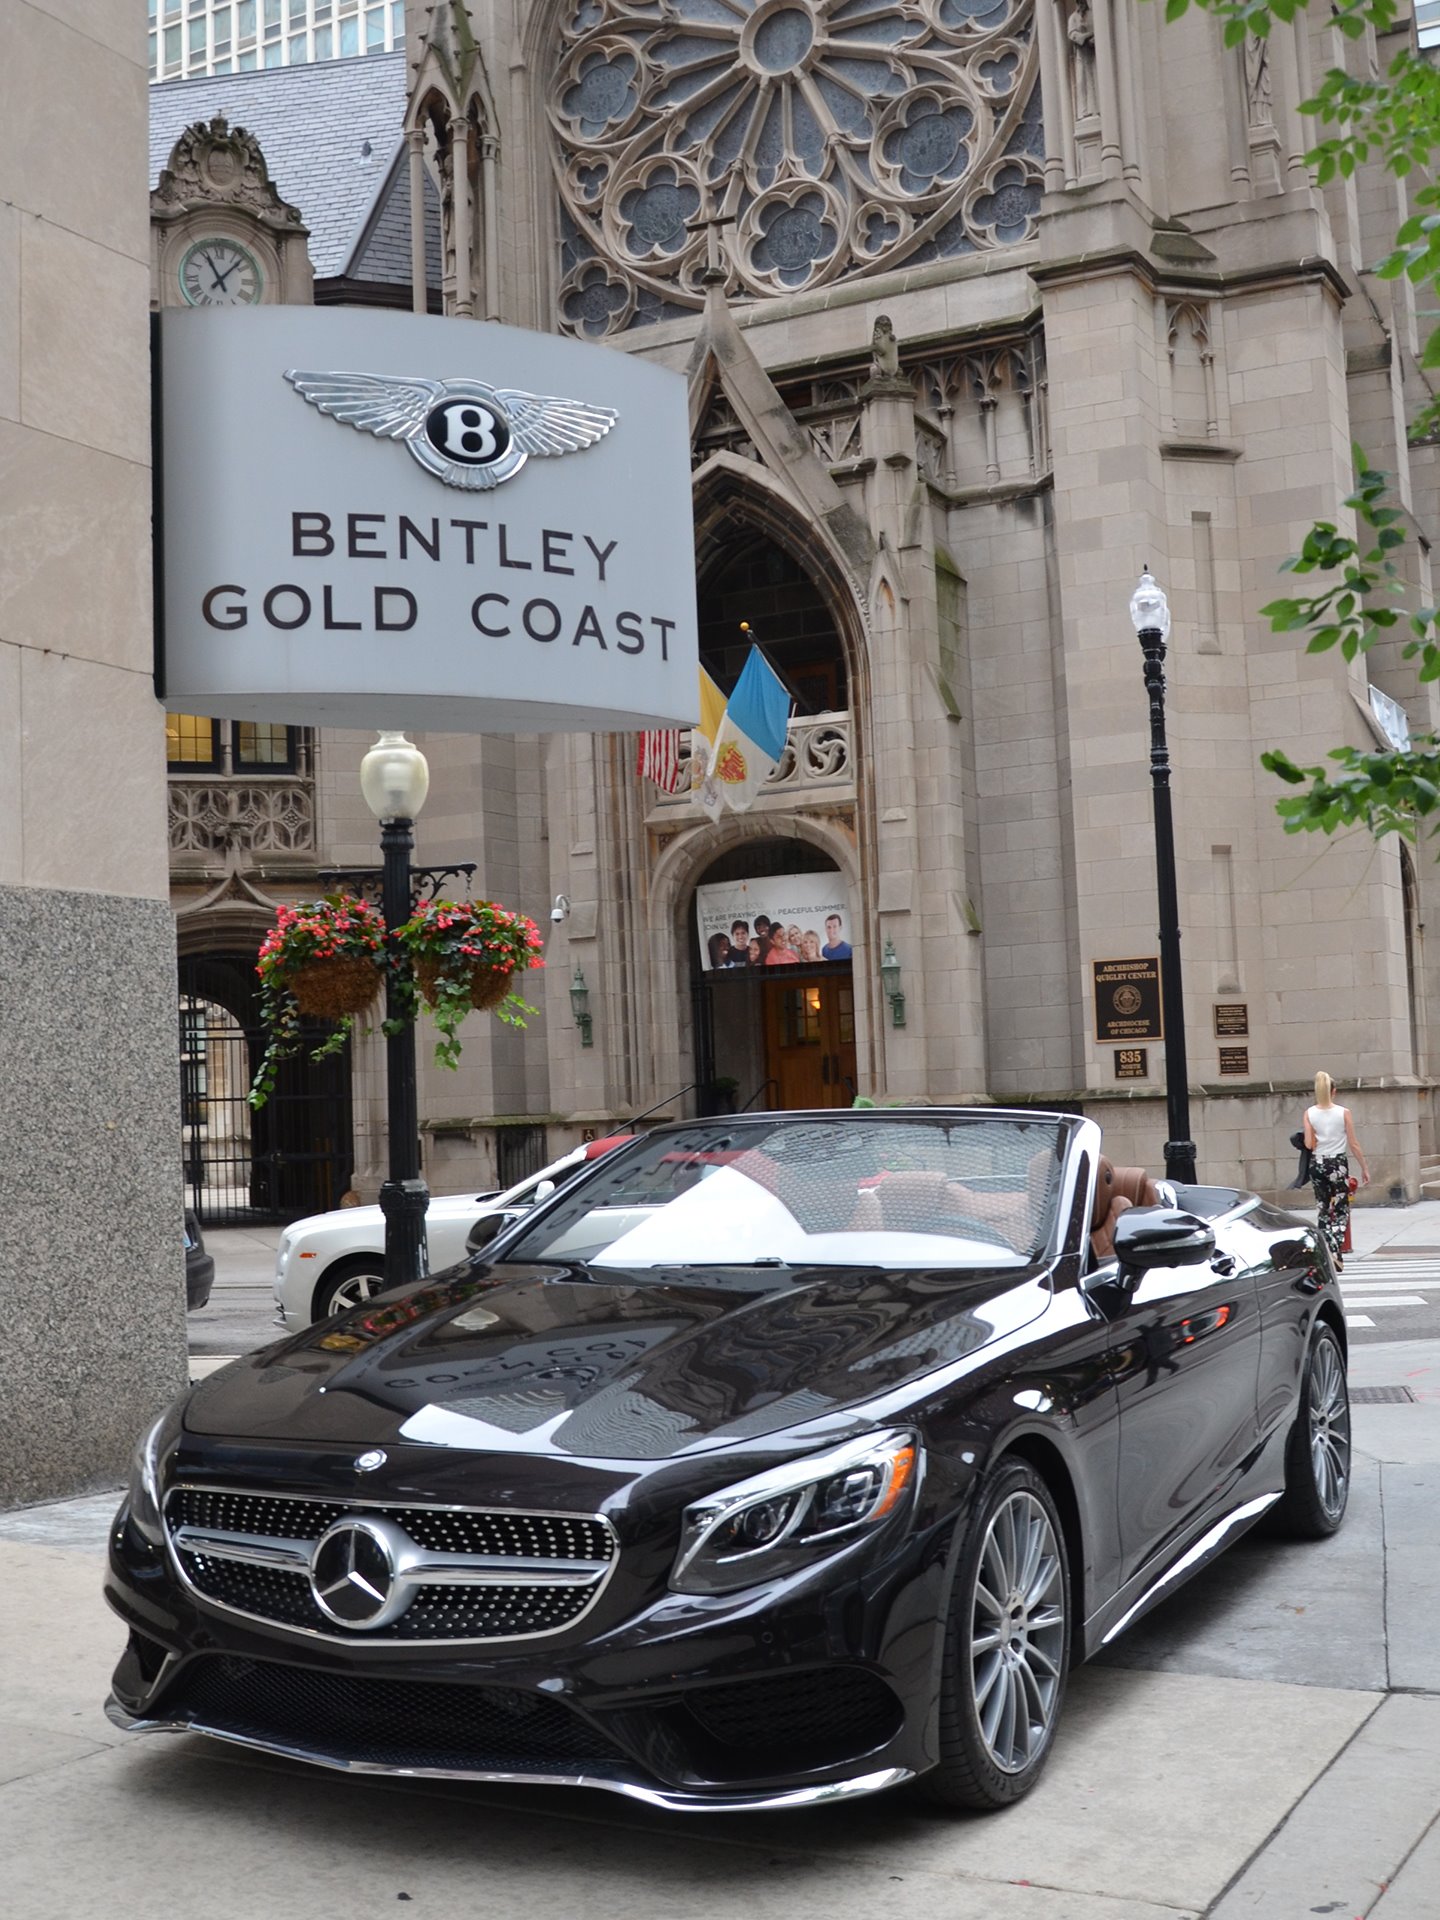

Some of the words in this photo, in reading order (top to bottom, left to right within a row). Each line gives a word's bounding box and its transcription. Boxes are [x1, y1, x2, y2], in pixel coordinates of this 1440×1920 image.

[443, 403, 498, 457] B
[292, 512, 617, 580] BENTLEY
[202, 584, 417, 631] GOLD
[471, 593, 675, 661] COAST
[728, 911, 757, 919] PRAYING
[778, 906, 814, 915] PEACEFUL
[1103, 963, 1149, 972] ARCHBISHOP
[1096, 973, 1127, 983] QUIGLEY
[1127, 971, 1157, 980] CENTER
[1120, 1050, 1141, 1063] 835
